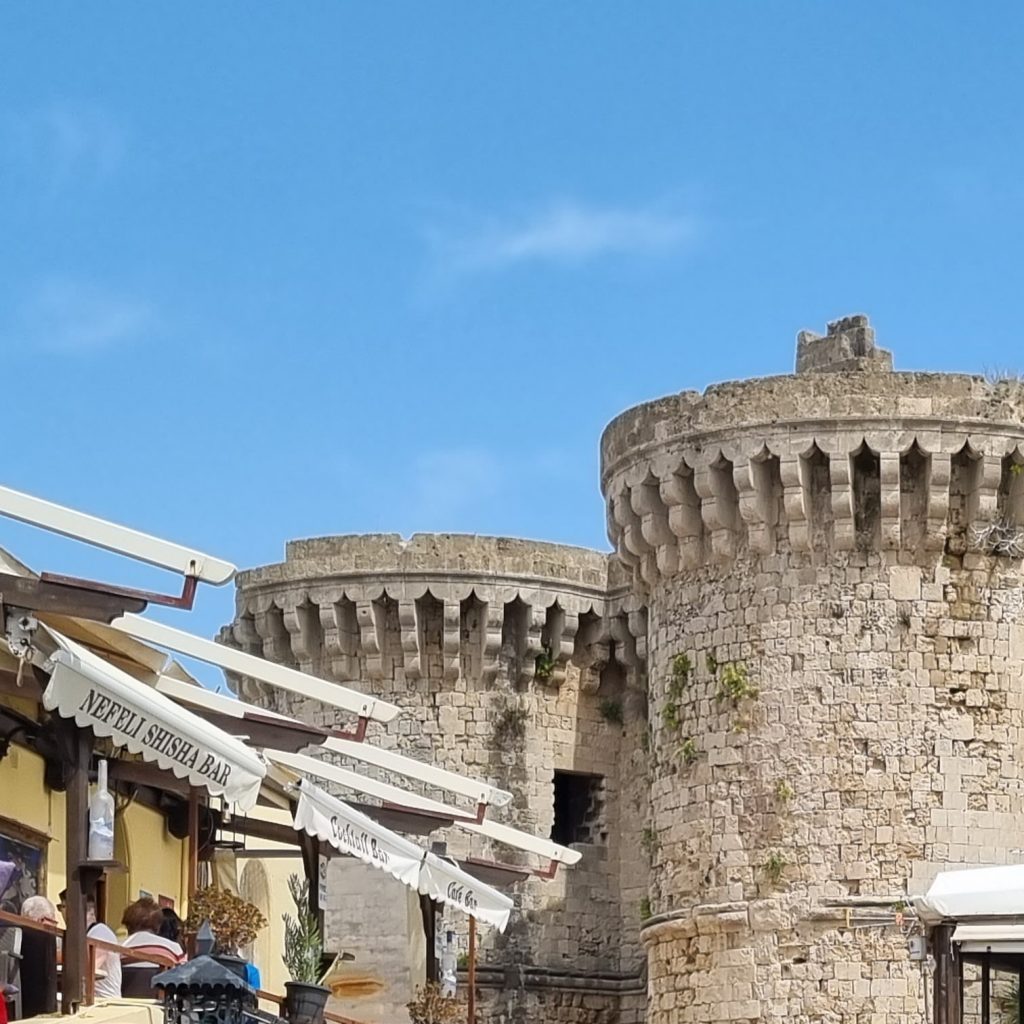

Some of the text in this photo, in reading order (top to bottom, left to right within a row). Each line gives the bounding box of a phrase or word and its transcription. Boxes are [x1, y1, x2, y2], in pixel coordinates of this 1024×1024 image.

[79, 690, 232, 787] NEFELI SHISHA BAR
